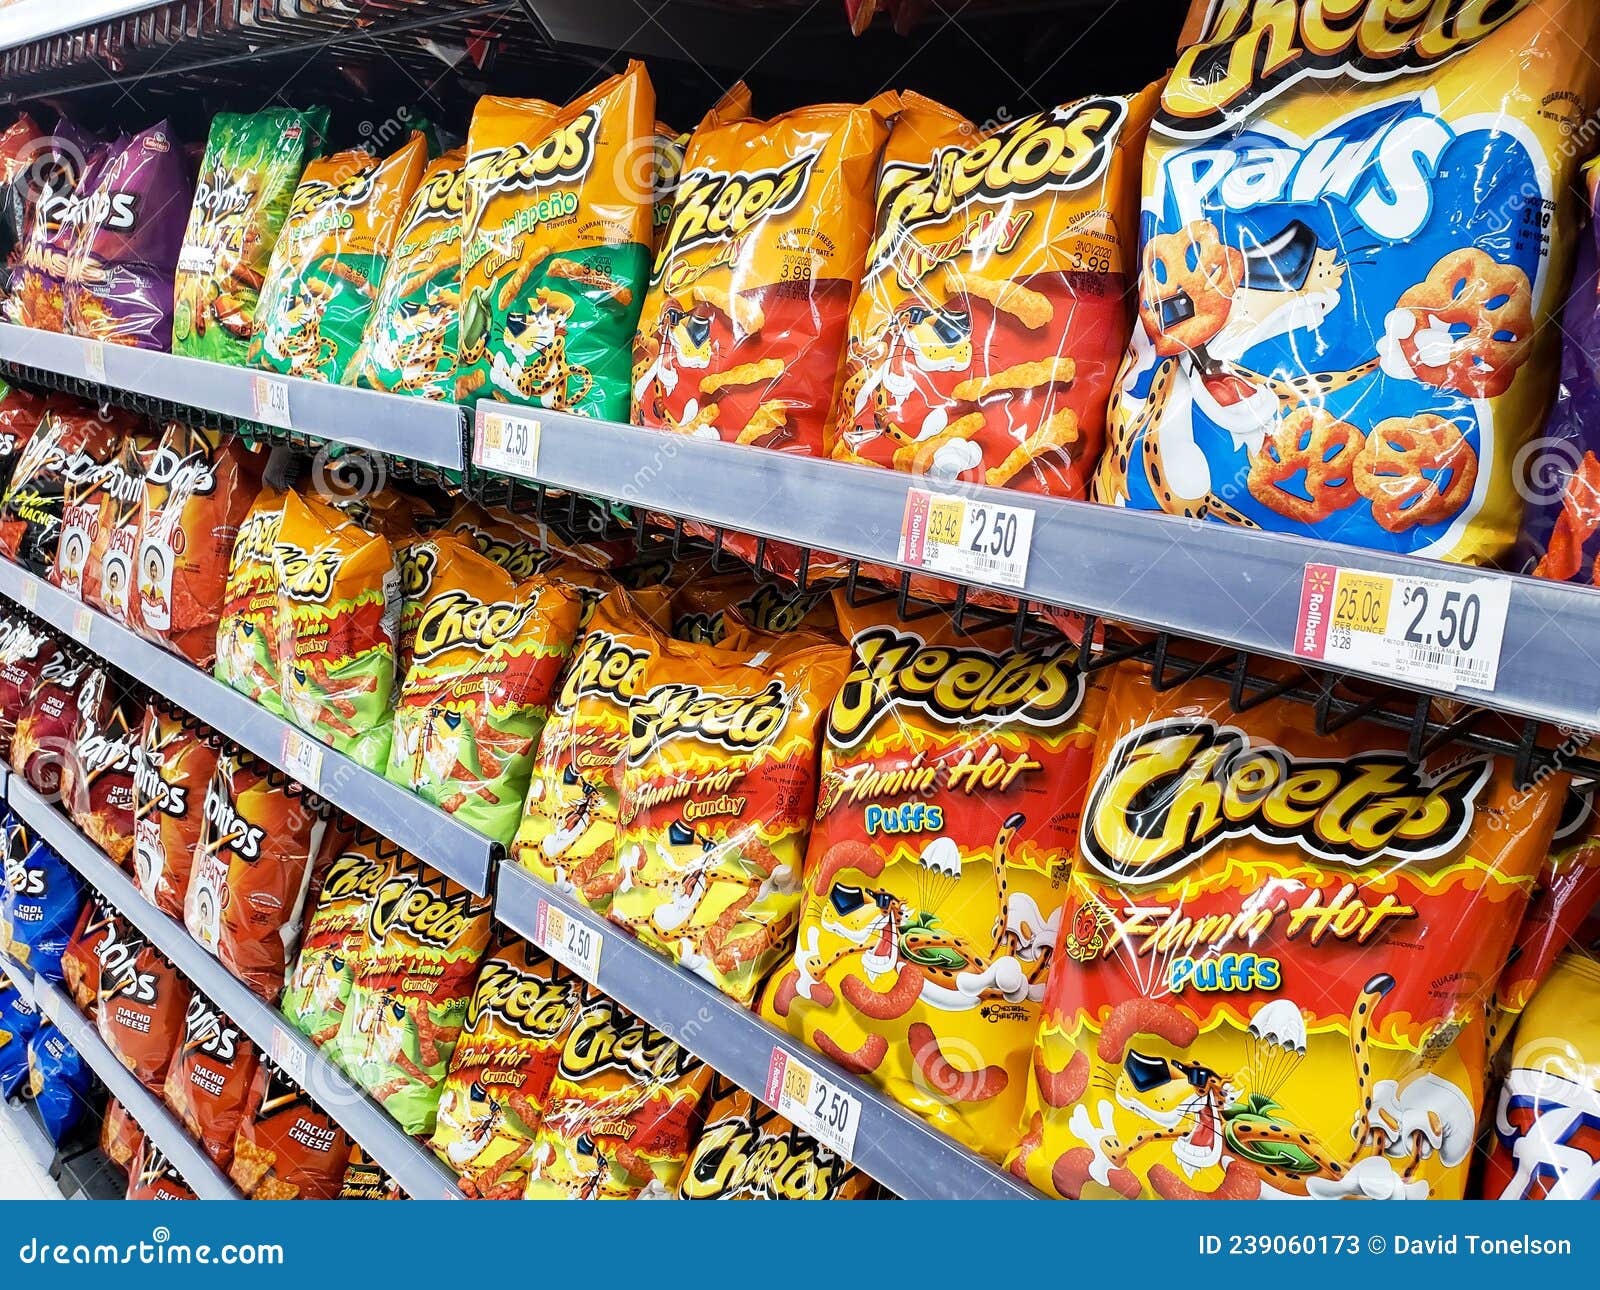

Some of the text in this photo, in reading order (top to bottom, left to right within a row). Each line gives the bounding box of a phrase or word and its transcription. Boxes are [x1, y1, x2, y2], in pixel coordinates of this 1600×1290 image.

[546, 216, 577, 231] Flavored
[778, 227, 836, 251] GUANTEED FRESH
[1074, 240, 1112, 259] 3NOV2020
[816, 249, 829, 257] DATE
[1072, 252, 1110, 276] 3.99
[583, 262, 612, 277] 3.99
[781, 264, 811, 281] 3.99
[908, 514, 922, 562] Rollback
[970, 508, 1018, 558] $2.50
[1363, 581, 1384, 591] PRICE
[1420, 580, 1439, 588] PRICE
[250, 596, 276, 611] Crunch
[1303, 592, 1323, 653] Rollback
[1334, 620, 1385, 635] PER OUNCE
[1403, 586, 1481, 651] $2.50
[1407, 641, 1432, 651] TURBOS
[830, 635, 1080, 736] Cheetos
[629, 684, 785, 764] Cheeto
[697, 767, 746, 797] Hot
[832, 751, 946, 810] Flamin'
[948, 744, 1042, 797] Hot
[682, 796, 744, 822] Crunchy
[1090, 732, 1468, 866] Cheetos
[205, 791, 265, 858] oritos
[865, 802, 944, 834] Puffs
[13, 910, 44, 922] RANCH
[18, 904, 43, 914] COOL
[1287, 884, 1415, 945] Hot
[1169, 953, 1282, 993] Puffs
[401, 978, 439, 995] Crunchy
[117, 1006, 152, 1024] NACHO
[446, 999, 466, 1009] 3.99
[115, 1012, 151, 1034] CHEESE
[494, 1046, 531, 1067] Hot
[190, 1071, 224, 1097] CHEESE
[194, 1063, 226, 1086] NACHO
[480, 1069, 528, 1088] Crunchy
[814, 1081, 849, 1132] $2.50
[288, 1126, 334, 1152] CHEESE
[295, 1117, 337, 1142] NACHO
[590, 1119, 638, 1141] Crunchy
